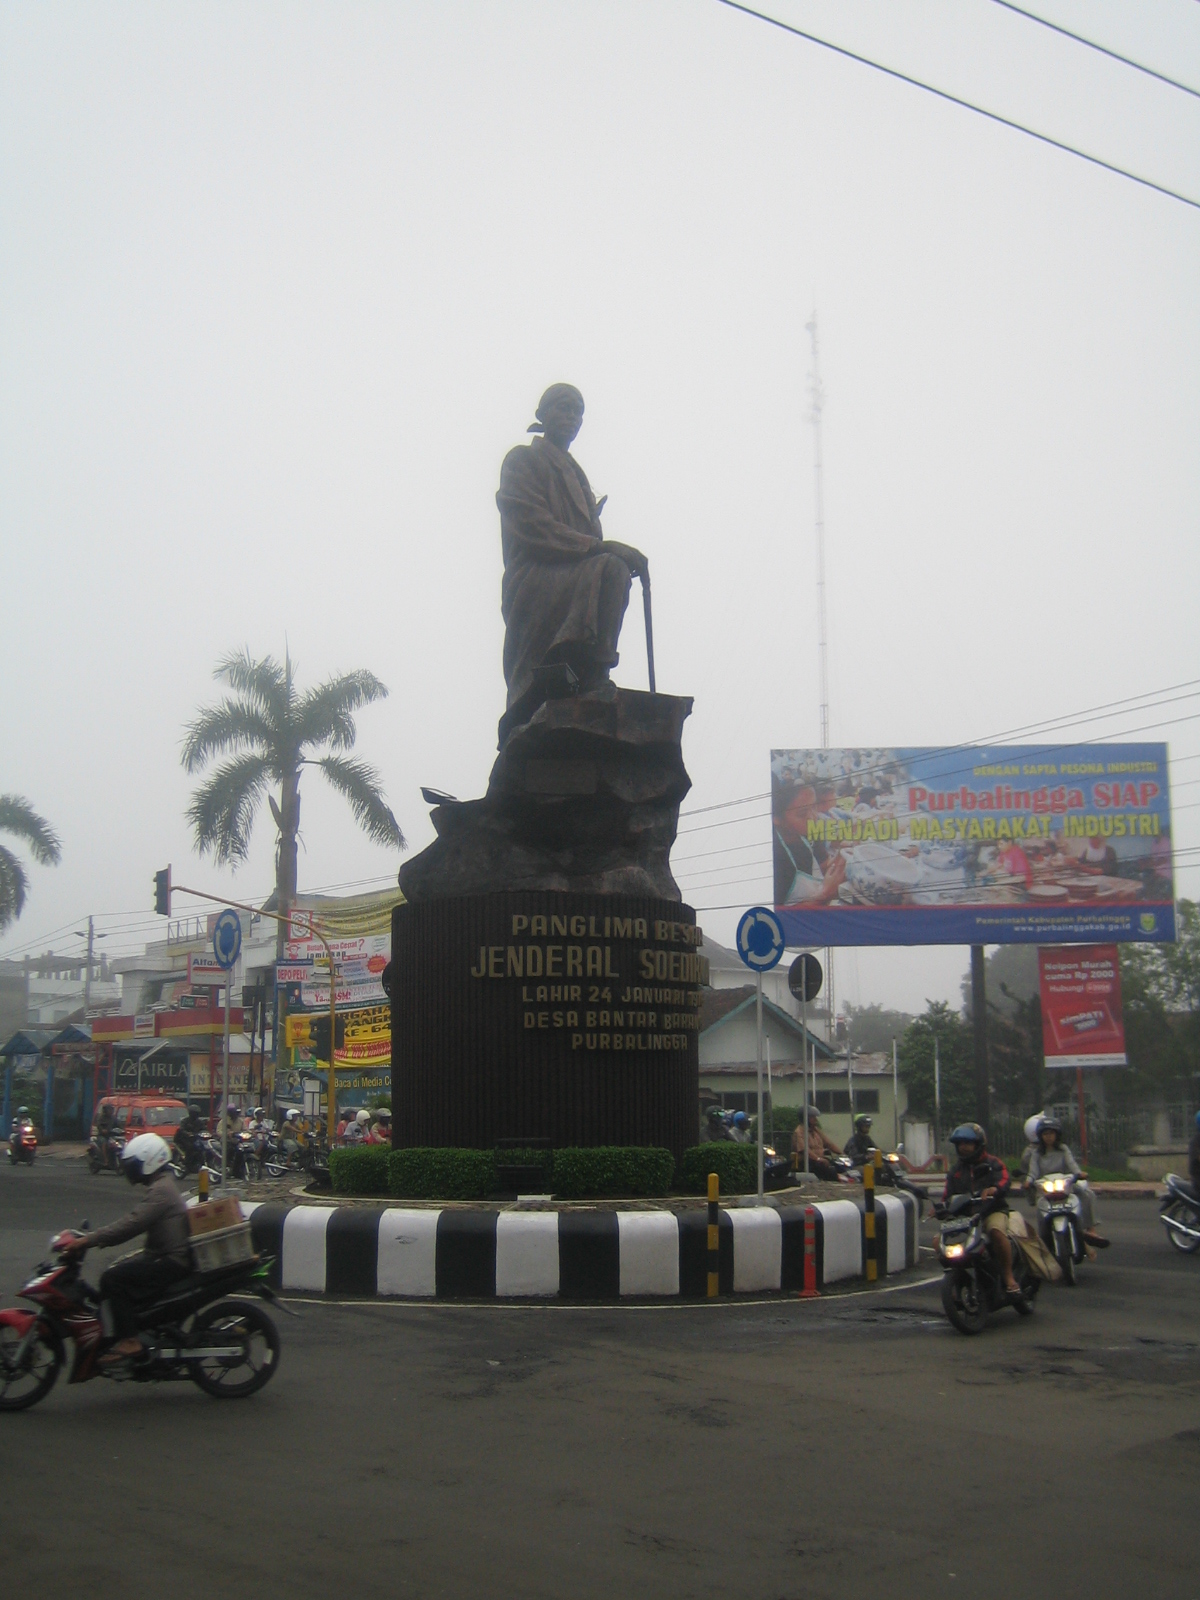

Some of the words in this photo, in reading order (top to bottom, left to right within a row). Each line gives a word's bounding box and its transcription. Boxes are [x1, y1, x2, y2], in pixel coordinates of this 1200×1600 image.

[973, 765, 1020, 776] DENGAN
[1023, 764, 1058, 775] SAPTA
[1060, 763, 1105, 774] PESONA
[1107, 762, 1158, 773] INDUSTRI
[908, 784, 1085, 814] Purbalingga
[1093, 782, 1159, 808] SIAP
[806, 817, 899, 842] MENJADI
[910, 816, 1052, 841] MASYARAKAT
[1063, 814, 1160, 838] INDUSTRI
[512, 914, 648, 940] PANGLIMA
[975, 917, 1026, 925] Pemerintah
[1028, 916, 1075, 925] Kabupaten
[1077, 915, 1131, 925] Purbalingga
[470, 945, 620, 979] JENDERAL
[1081, 960, 1112, 969] Murah
[1074, 971, 1088, 980] Rp
[1090, 970, 1114, 979] 2000
[522, 986, 582, 1002] LAHIR
[588, 986, 612, 1003] 24
[621, 987, 685, 1006] JANUARI
[1049, 984, 1084, 993] Hubungi
[523, 1010, 579, 1029] DESA
[585, 1010, 657, 1029] BANTAR
[571, 1033, 688, 1051] PURBALINGGA
[353, 1077, 360, 1088] di
[362, 1076, 383, 1087] Media
